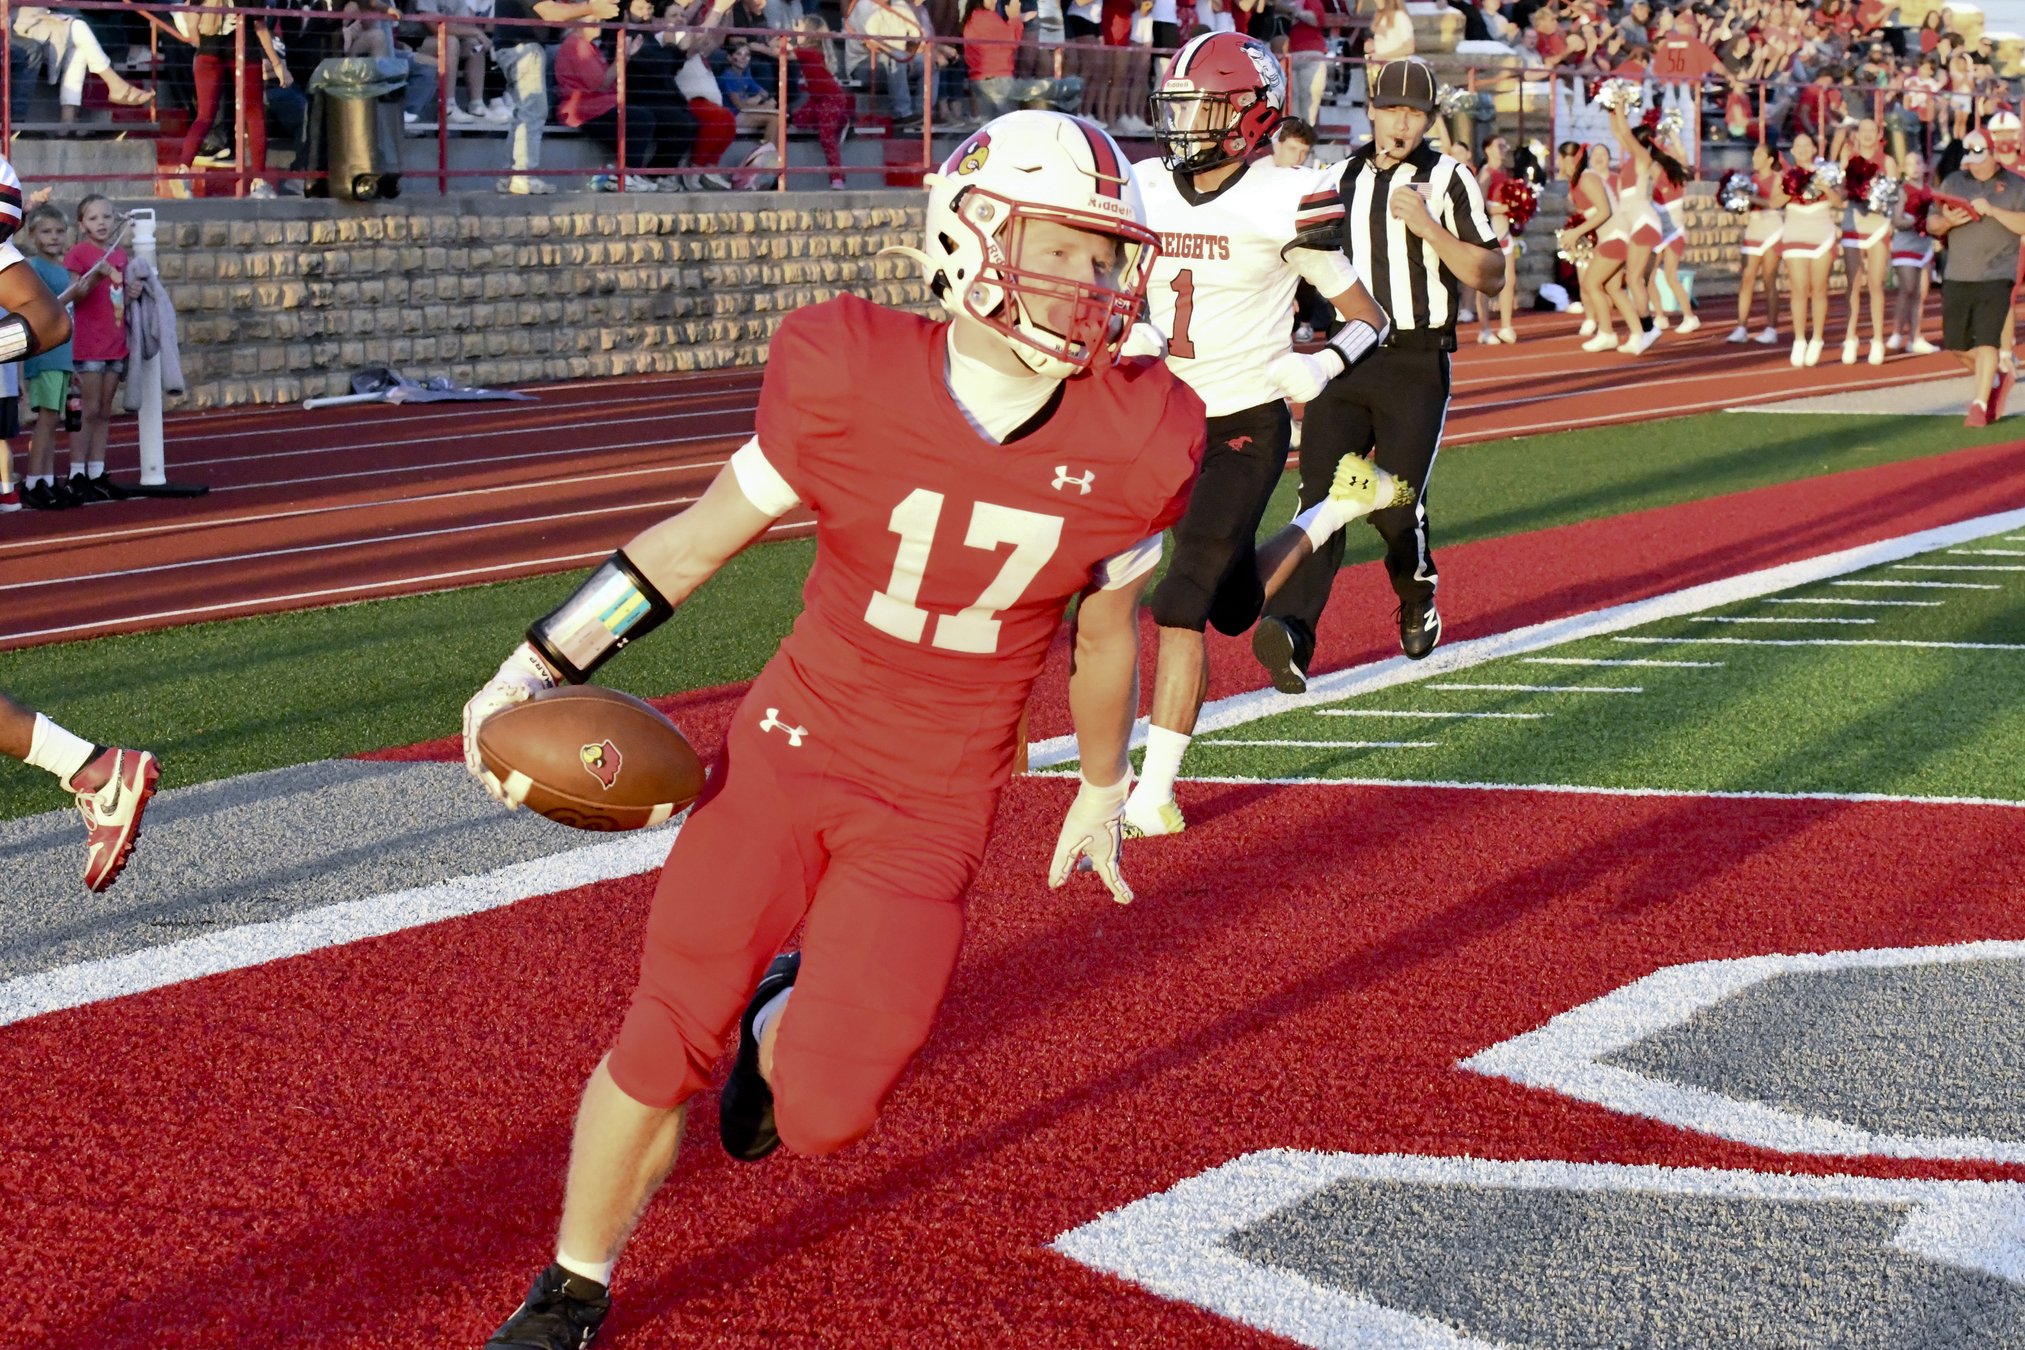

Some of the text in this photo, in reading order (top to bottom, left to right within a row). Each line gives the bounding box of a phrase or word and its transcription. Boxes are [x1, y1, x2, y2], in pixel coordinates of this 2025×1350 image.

[1667, 48, 1685, 73] 56
[1167, 268, 1195, 360] 1
[863, 487, 1065, 655] 17
